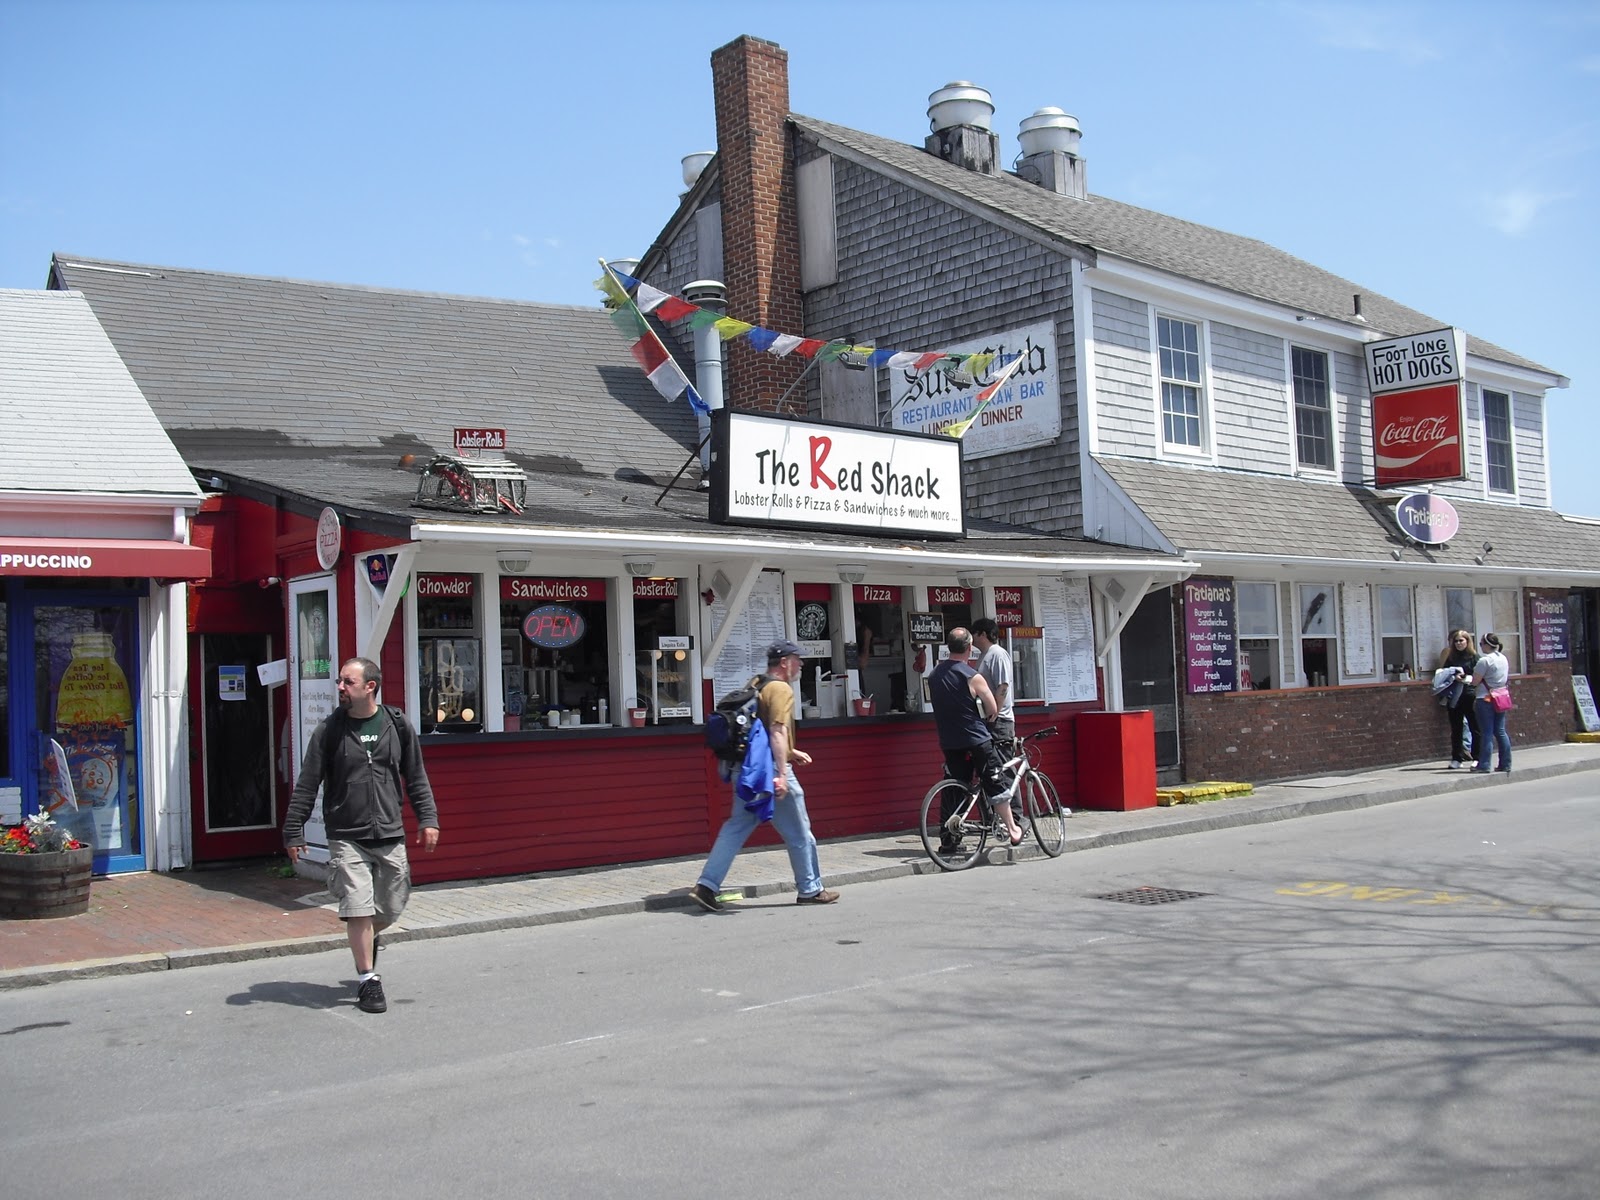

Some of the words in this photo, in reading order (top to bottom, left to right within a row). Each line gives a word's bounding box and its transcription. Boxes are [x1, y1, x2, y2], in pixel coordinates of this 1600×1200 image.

[1372, 345, 1409, 365] FOOT
[1412, 339, 1449, 358] LONG
[1373, 362, 1403, 385] HOT
[1408, 355, 1453, 380] DOGS
[902, 396, 974, 425] RESTAURANT
[1020, 381, 1045, 400] BAR
[981, 405, 1023, 427] DINNER
[455, 431, 486, 447] Lobster
[486, 431, 503, 447] Rolls
[1380, 416, 1449, 447] Coca-Cola
[755, 449, 800, 487] The
[809, 435, 862, 493] Red
[871, 461, 940, 500] Shack
[734, 490, 769, 507] Lobster
[772, 493, 793, 508] Rolls
[796, 496, 802, 508] &
[805, 496, 831, 511] Pizza
[834, 499, 841, 512] &
[843, 500, 898, 517] Sandwiches
[900, 505, 906, 517] &
[908, 506, 929, 519] much
[0, 554, 92, 569] PPUCCINO
[417, 577, 472, 595] Chowder
[511, 580, 588, 598] Sandwiches
[1185, 584, 1231, 603] Tatiana's
[863, 586, 891, 602] Pizza
[935, 588, 965, 603] Salads
[1005, 590, 1021, 604] Dogs
[1194, 609, 1215, 619] Burgers
[1218, 609, 1223, 617] &
[1536, 601, 1563, 614] Tatiana's
[995, 613, 1007, 622] orn
[1008, 612, 1022, 625] Dogs
[1198, 618, 1228, 626] Sandwiches
[524, 615, 580, 638] OPEN
[910, 620, 931, 632] Lobster
[931, 621, 943, 633] Rolls
[1190, 633, 1217, 641] Hand-Cut
[1218, 632, 1231, 641] Fries
[1196, 643, 1211, 651] Onion
[1213, 643, 1227, 653] Rings
[1191, 659, 1213, 668] Scallops
[1217, 658, 1232, 666] Clams
[1204, 672, 1220, 680] Fresh
[1194, 684, 1208, 692] Local
[1210, 682, 1231, 692] Seafood
